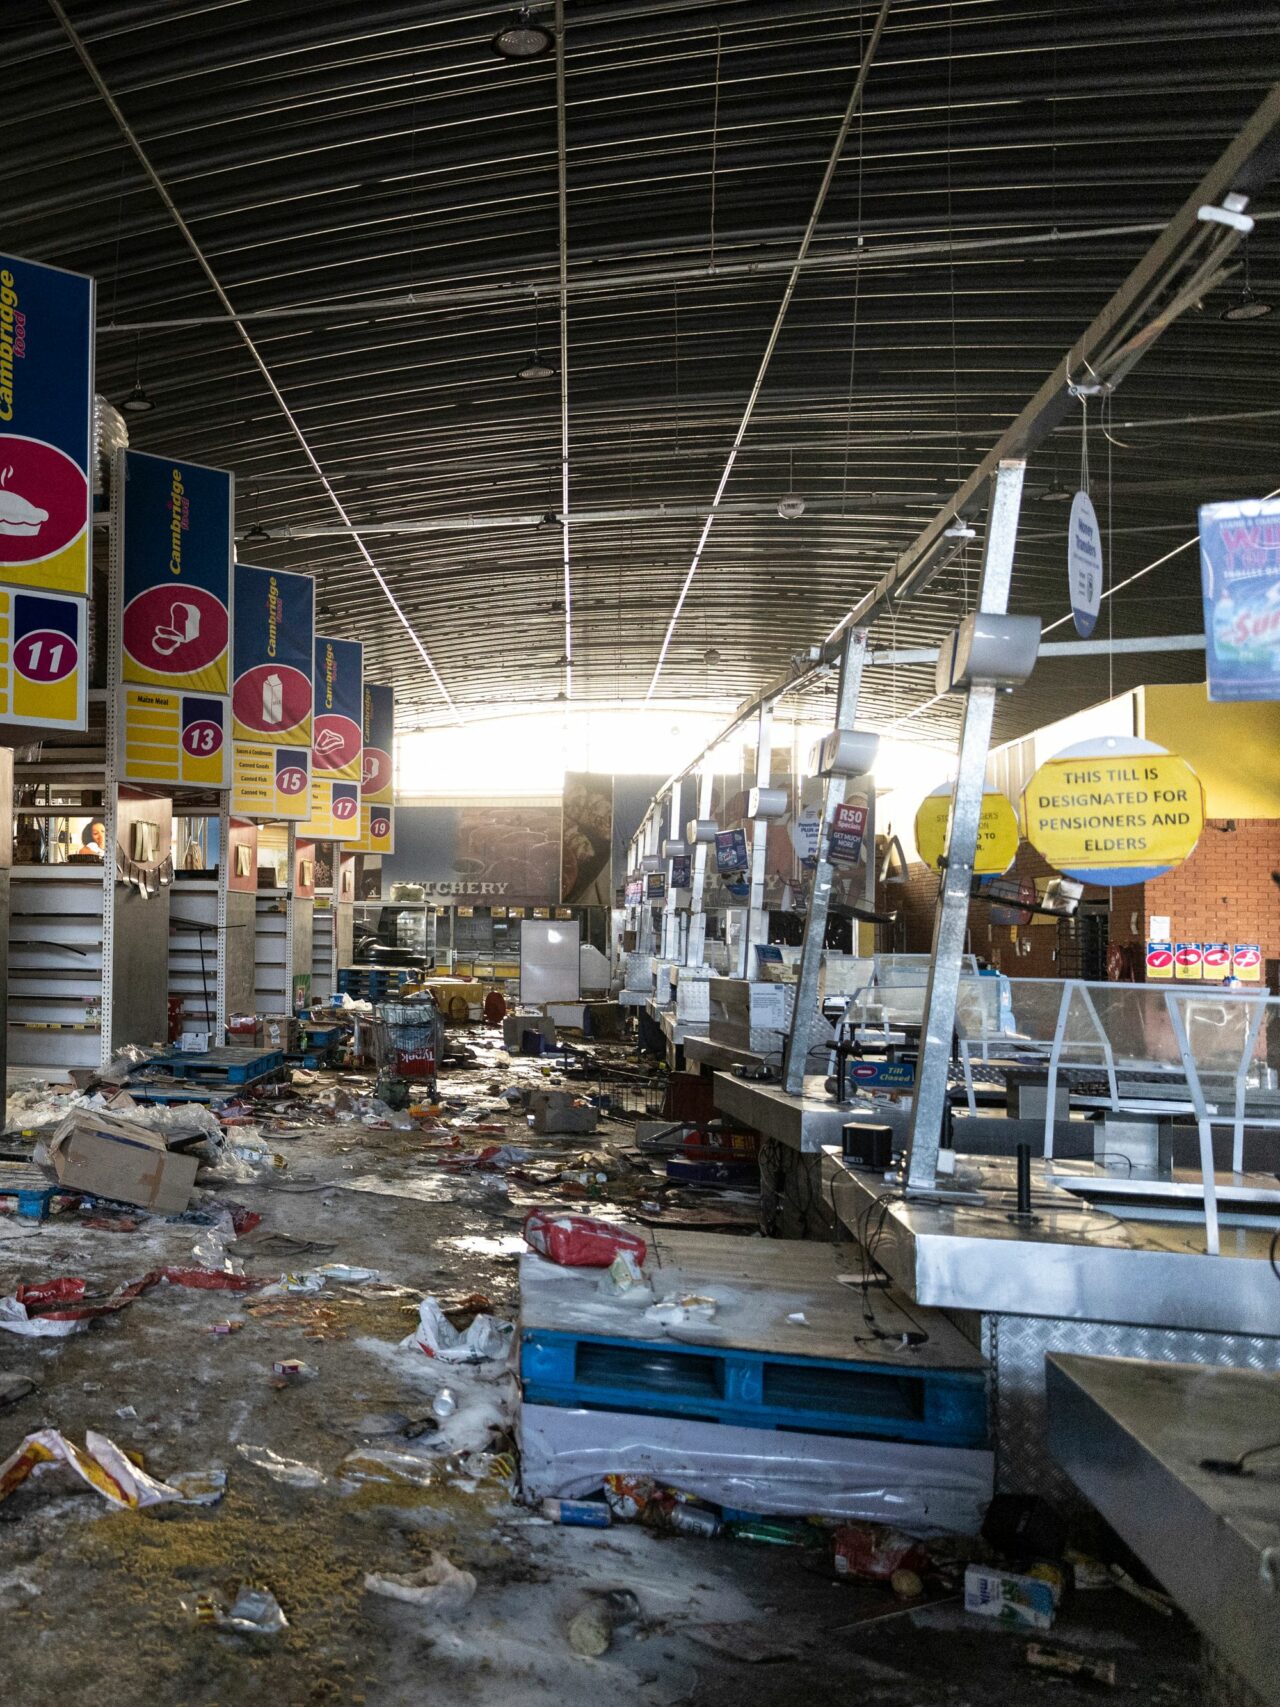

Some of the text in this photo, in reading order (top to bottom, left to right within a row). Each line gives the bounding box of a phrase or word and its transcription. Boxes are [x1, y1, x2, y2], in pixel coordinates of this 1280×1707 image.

[13, 309, 26, 359] food
[168, 469, 184, 575] Cambridge
[1222, 523, 1280, 550] WI
[265, 576, 279, 657] Cambridge
[28, 641, 64, 673] 11
[324, 643, 335, 709] Cambridge
[137, 695, 169, 706] Maize Meal
[191, 728, 215, 751] 13
[282, 772, 301, 790] 15
[1064, 768, 1159, 784] THIS TILL IS
[1038, 789, 1188, 808] DESIGNATED FOR
[337, 802, 352, 816] 17
[839, 809, 863, 823] R50
[374, 822, 386, 835] 19
[1039, 812, 1190, 831] PENSIONERS AND
[837, 840, 854, 848] MORE
[844, 833, 861, 842] MUCH
[984, 832, 996, 840] TO
[1084, 838, 1147, 852] ELDERS
[395, 881, 509, 895] TCHERY
[880, 1073, 911, 1082] Closed
